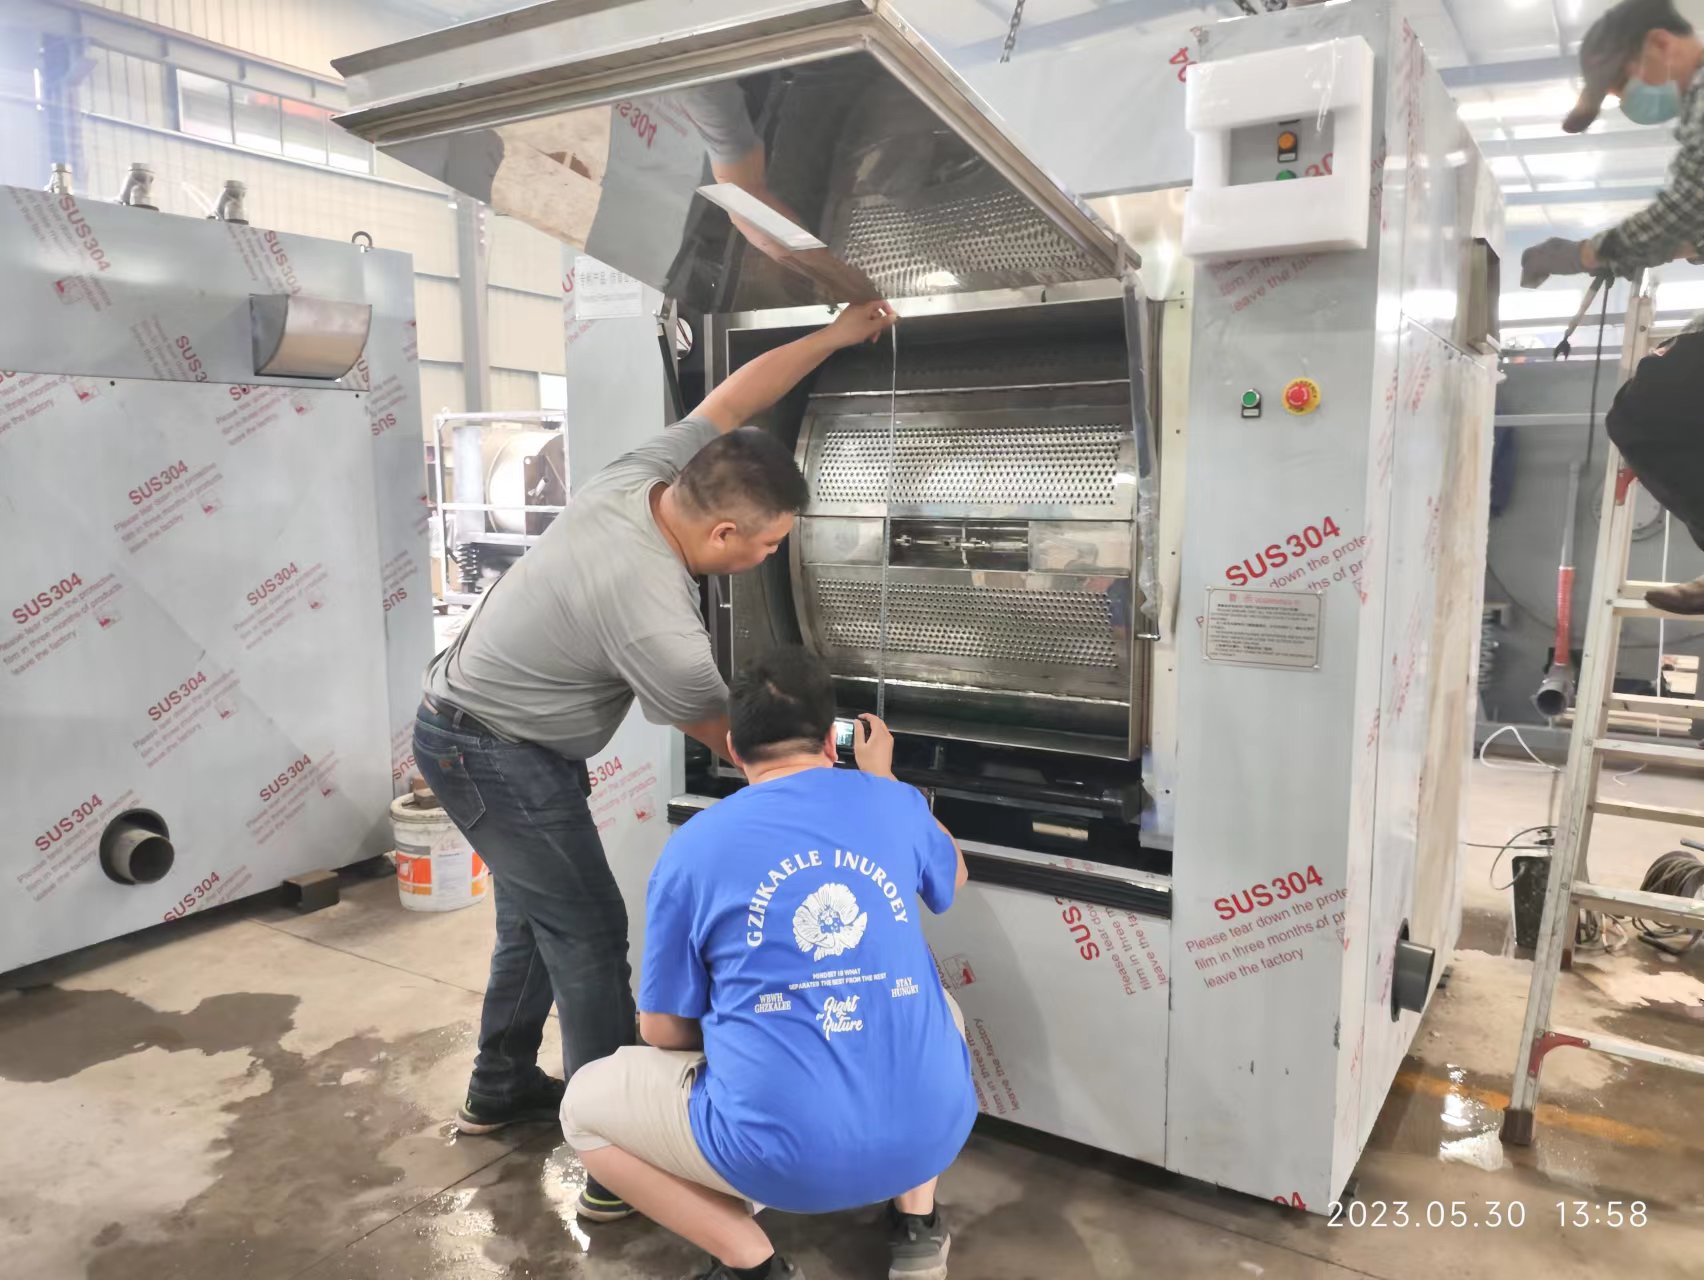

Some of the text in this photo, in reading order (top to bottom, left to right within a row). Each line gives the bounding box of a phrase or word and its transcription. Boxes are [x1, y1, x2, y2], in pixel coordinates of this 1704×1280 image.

[60, 193, 111, 272] SUS304
[128, 460, 188, 505] SUS304
[1225, 516, 1340, 586] SUS304
[1307, 555, 1330, 572] the
[246, 562, 298, 606] SUS304
[1333, 566, 1348, 582] of
[12, 572, 82, 625] SUS304
[147, 671, 207, 721] SUS304
[259, 753, 313, 802] SUS304
[34, 793, 103, 852] SUS304
[164, 871, 220, 921] SUS304
[746, 850, 822, 948] GZHKAELE
[1214, 865, 1323, 921] SUS304
[1097, 927, 1115, 951] tear
[1135, 929, 1150, 950] the
[1185, 930, 1228, 953] Please
[1229, 922, 1254, 938] tear
[1256, 908, 1291, 929] down
[1292, 900, 1314, 916] the
[1194, 956, 1218, 971] film
[1219, 949, 1232, 963] in
[1231, 939, 1265, 958] three
[1266, 922, 1314, 947] months
[1318, 915, 1330, 929] of
[812, 970, 837, 980] MINDSET
[844, 967, 861, 977] WHAT
[1111, 953, 1136, 996] Please
[1112, 920, 1152, 991] film in three
[1146, 951, 1168, 985] leave
[1203, 947, 1304, 989] leave the factory
[845, 976, 861, 985] FROM
[861, 974, 873, 982] THE
[892, 984, 919, 998] HUNGRY
[896, 977, 912, 988] STAY
[973, 1017, 993, 1057] factory
[992, 1057, 1005, 1078] the
